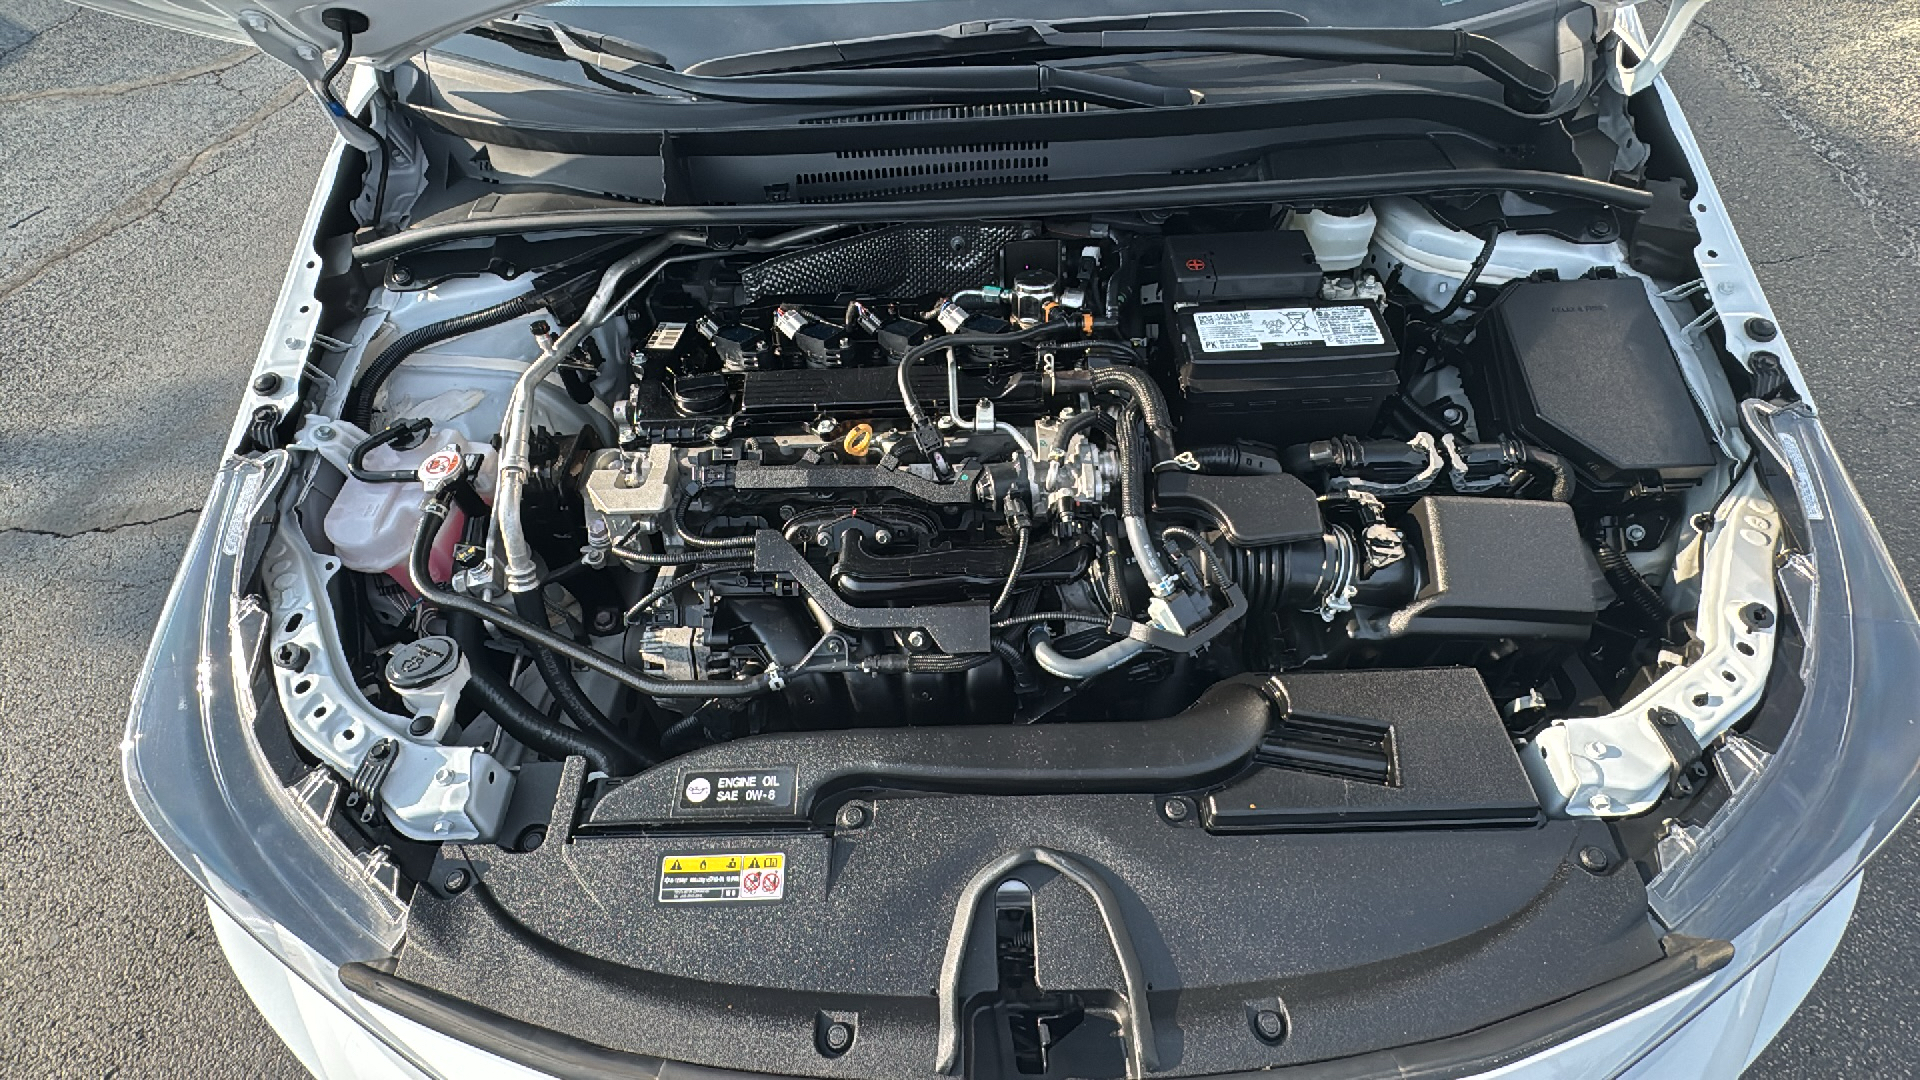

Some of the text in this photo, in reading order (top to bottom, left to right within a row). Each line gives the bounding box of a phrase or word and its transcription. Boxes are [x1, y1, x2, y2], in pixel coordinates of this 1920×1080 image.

[717, 775, 780, 789] ENGINE OIL
[716, 790, 739, 802] SAE
